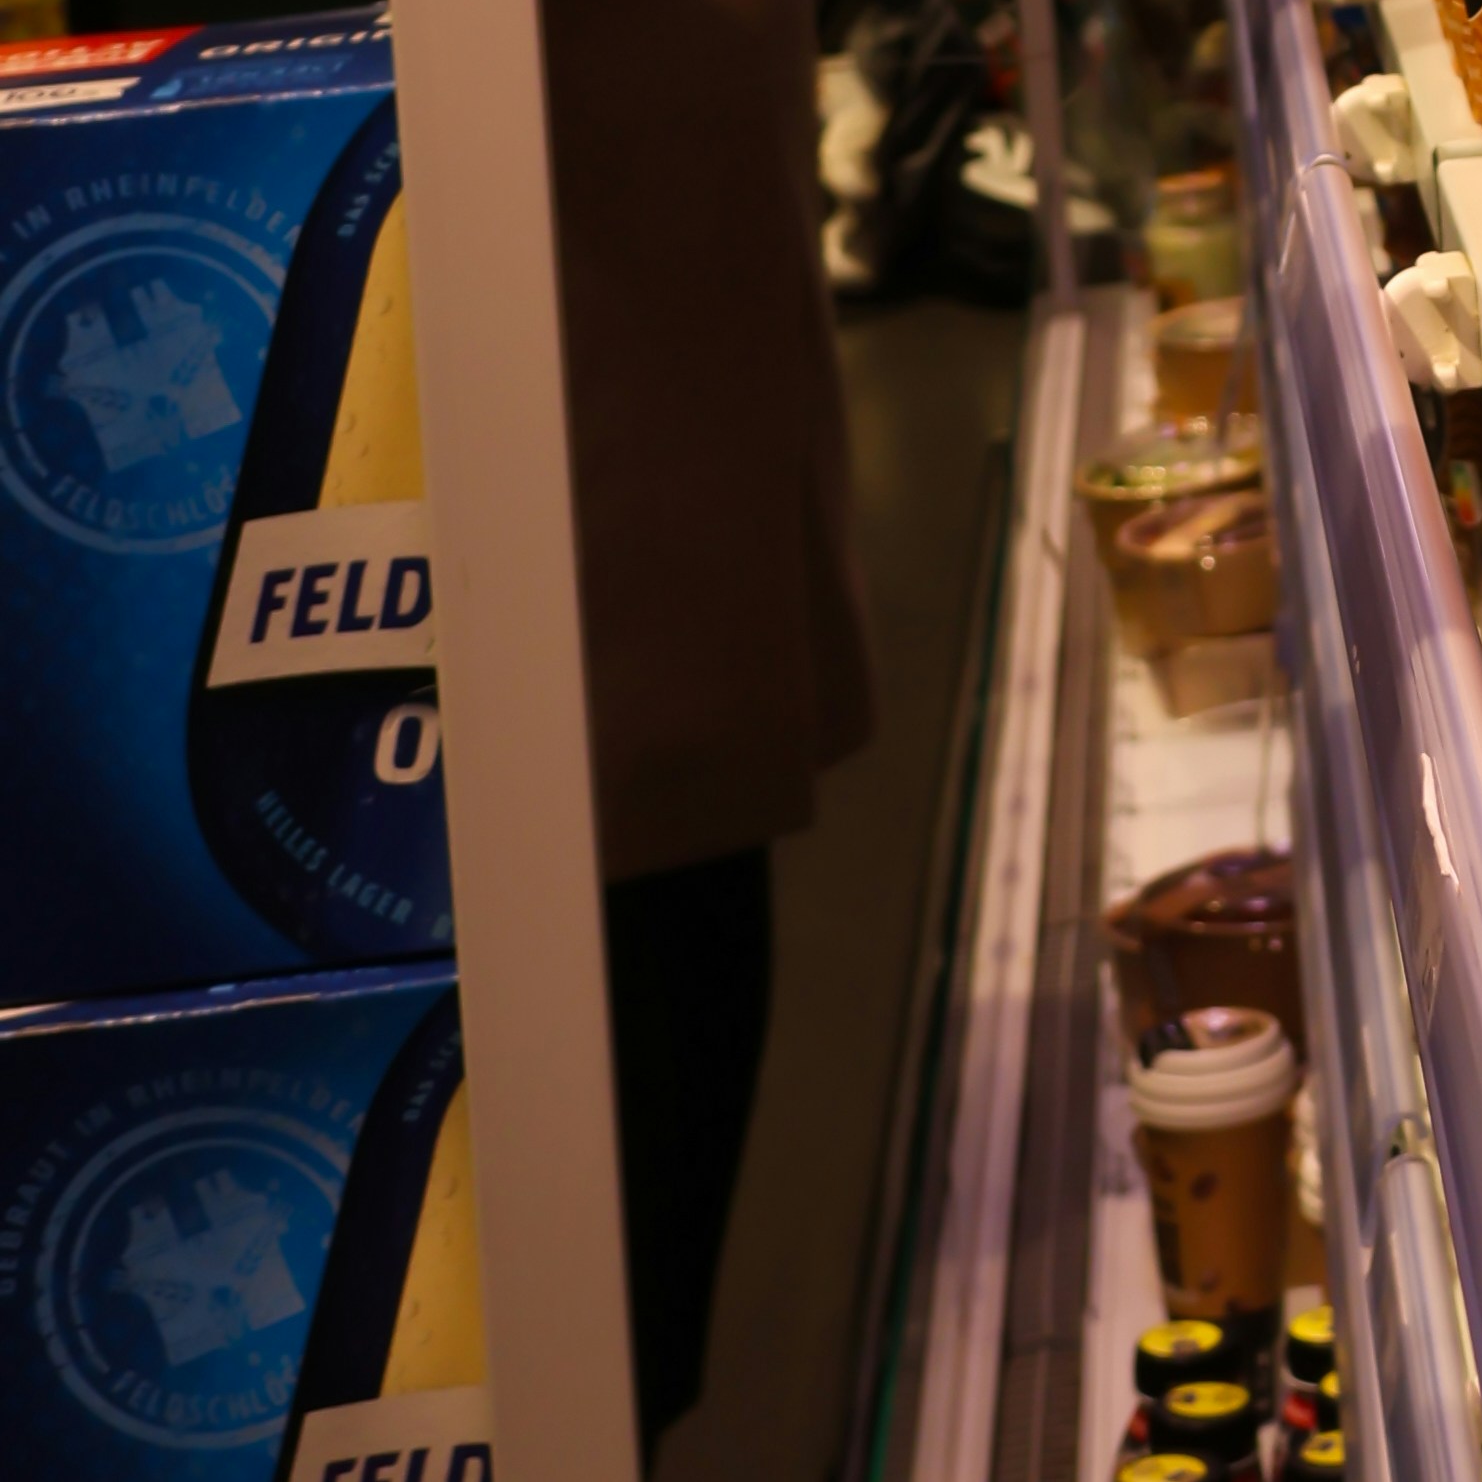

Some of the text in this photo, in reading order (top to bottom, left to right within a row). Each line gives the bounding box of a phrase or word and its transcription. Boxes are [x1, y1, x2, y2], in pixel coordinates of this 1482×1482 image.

[249, 557, 433, 644] FELD
[252, 787, 415, 925] HELLES LAGER
